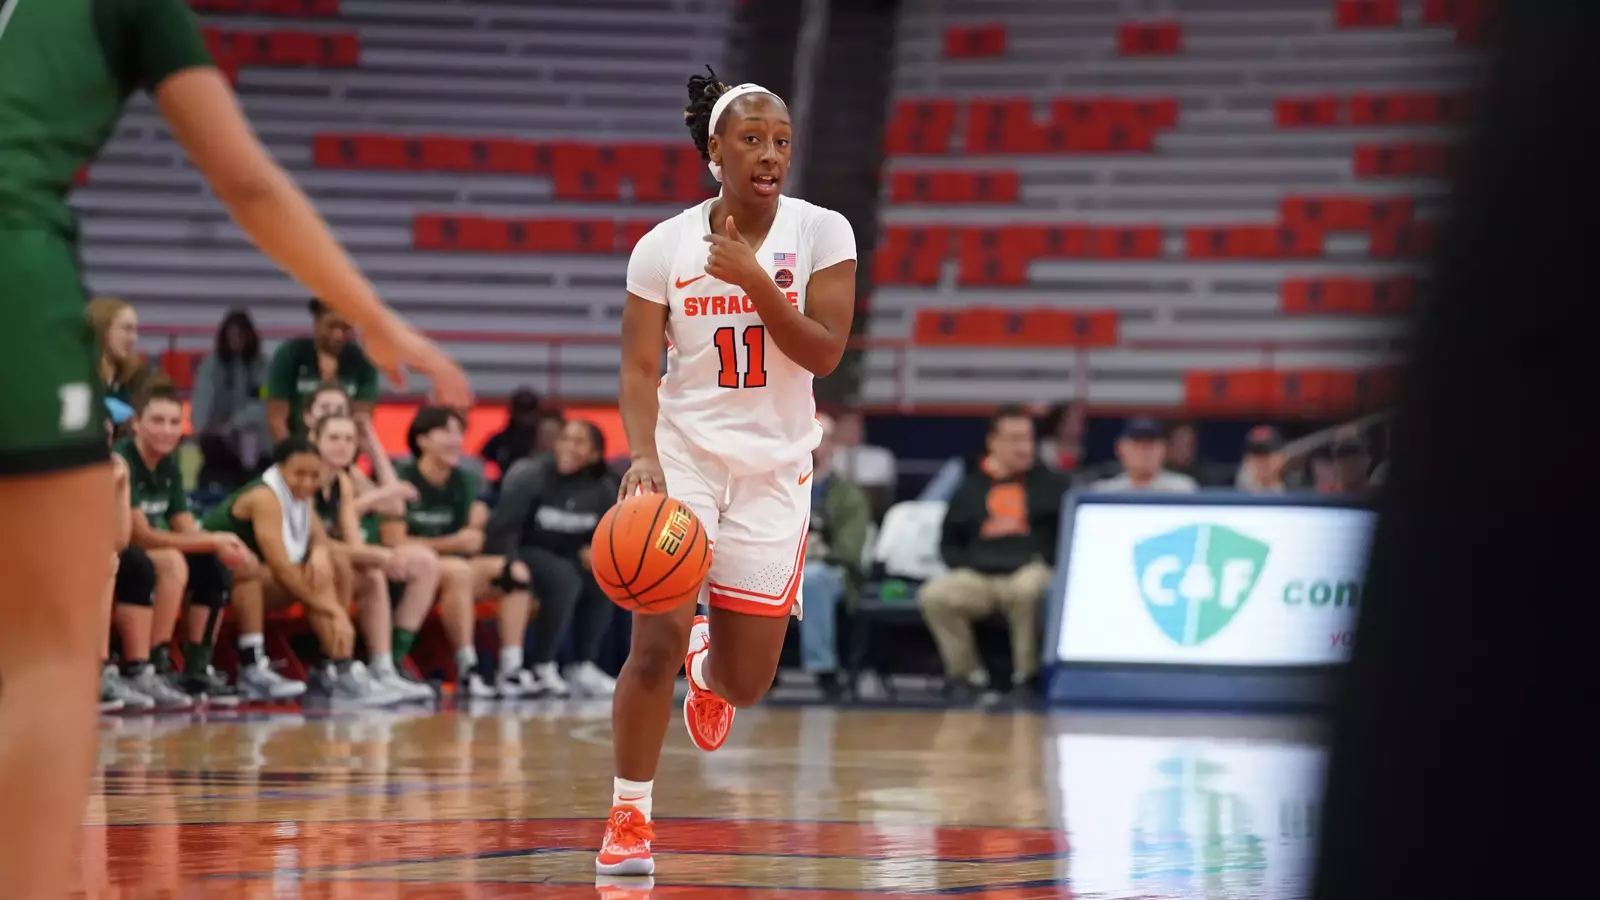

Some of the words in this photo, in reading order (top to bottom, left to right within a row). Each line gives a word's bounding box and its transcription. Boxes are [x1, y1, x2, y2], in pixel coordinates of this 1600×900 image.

[684, 291, 799, 316] SYRACE
[713, 325, 767, 388] 11
[661, 505, 692, 557] ELITE
